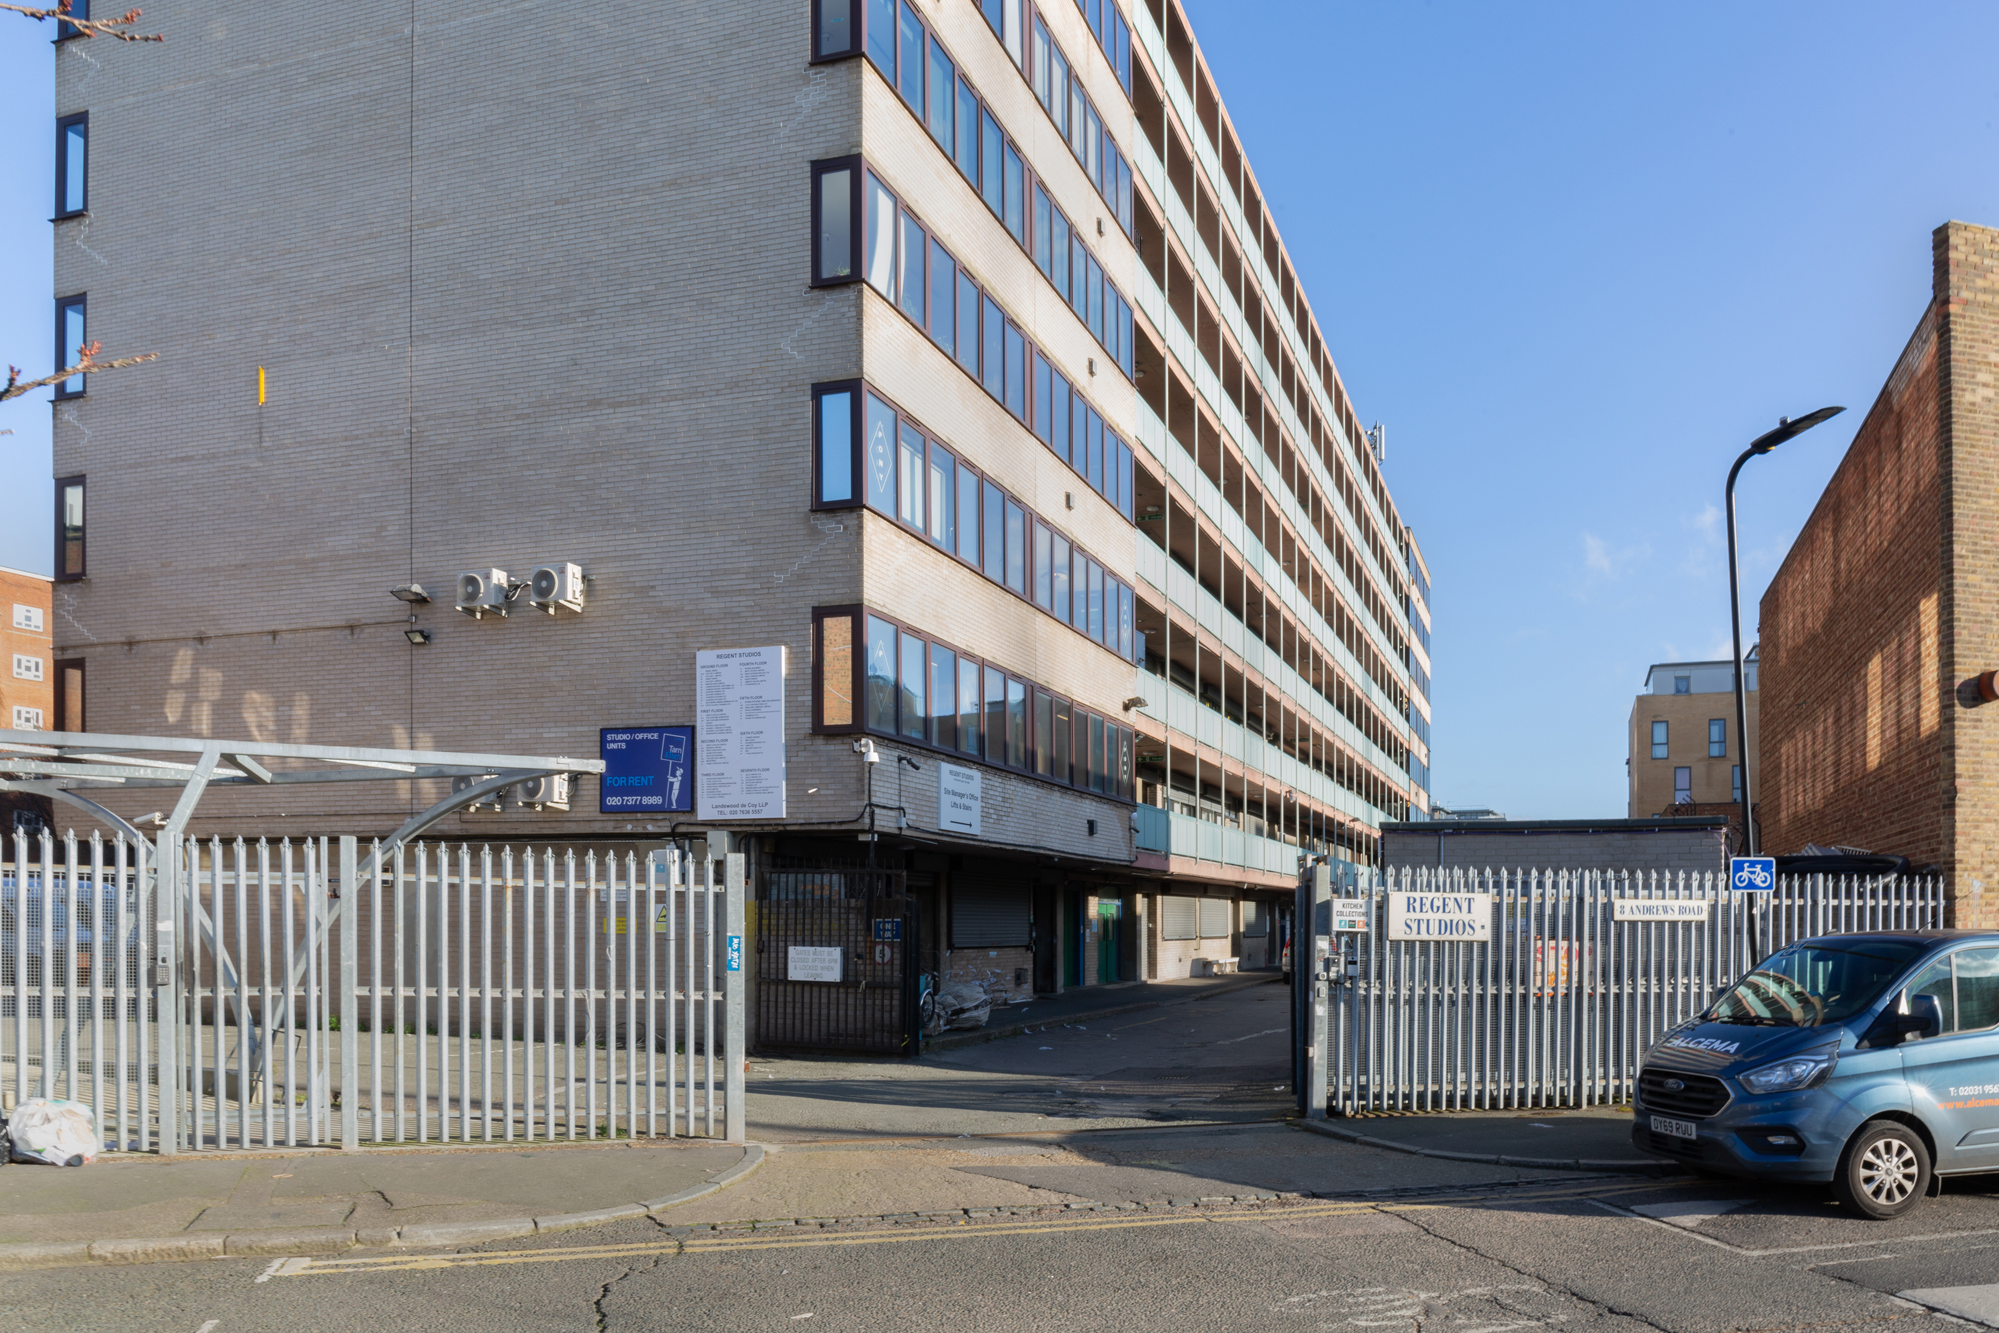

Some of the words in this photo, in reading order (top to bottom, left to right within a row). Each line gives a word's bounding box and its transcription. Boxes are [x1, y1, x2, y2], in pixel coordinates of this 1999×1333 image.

[606, 733, 631, 741] STUDIO
[606, 742, 626, 750] UNITS
[606, 776, 627, 787] FOR
[628, 775, 655, 787] RENT
[606, 796, 622, 805] 020
[622, 796, 641, 805] 7377
[641, 796, 663, 805] 8989
[943, 787, 951, 796] Site
[951, 788, 969, 800] Manager's
[969, 792, 979, 802] Office
[950, 800, 959, 809] Lifts
[962, 803, 972, 812] Stairs
[1405, 896, 1475, 914] REGENT
[1619, 904, 1625, 916] 8
[1628, 904, 1676, 916] ANDREWS
[1678, 904, 1703, 916] ROAD
[1404, 917, 1476, 936] STUDIOS
[1667, 1037, 1741, 1054] ALCEMA
[1948, 1086, 1957, 1096] T:
[1958, 1085, 1982, 1096] 02031
[1983, 1083, 1999, 1094] 956
[1653, 1117, 1674, 1133] OY69
[1675, 1122, 1693, 1137] RUU
